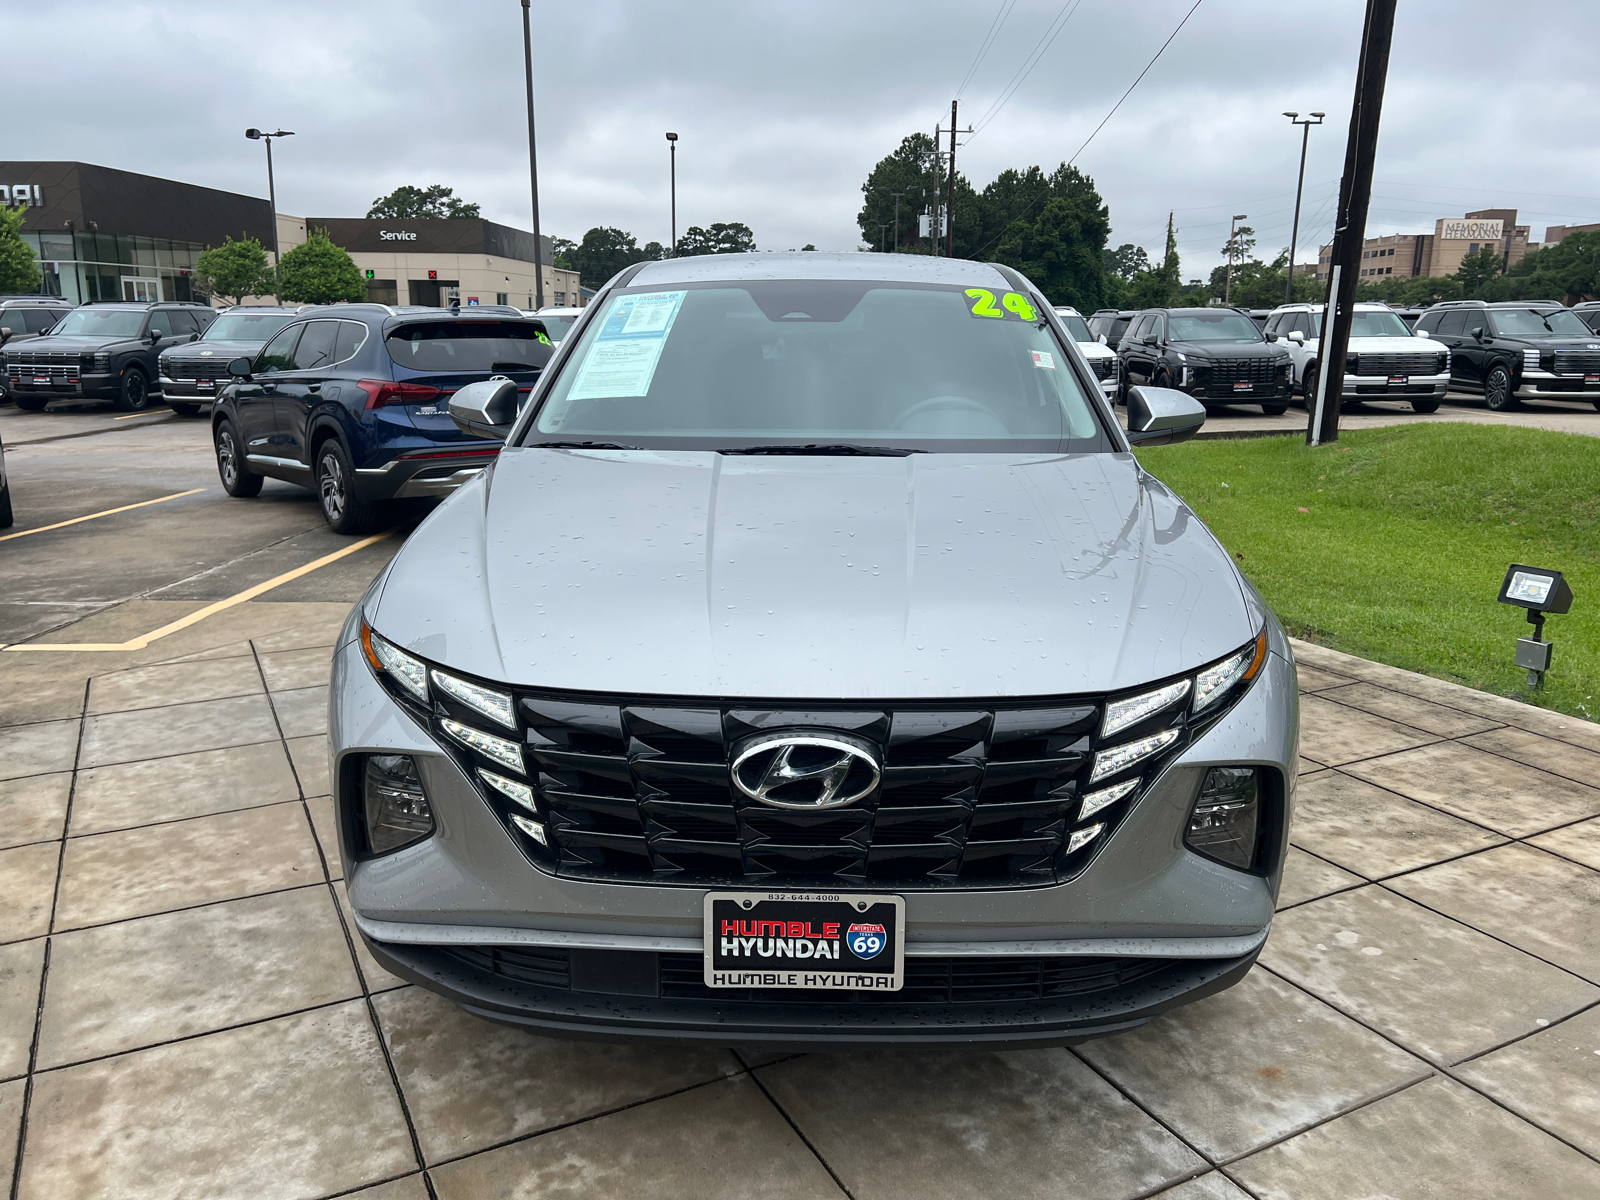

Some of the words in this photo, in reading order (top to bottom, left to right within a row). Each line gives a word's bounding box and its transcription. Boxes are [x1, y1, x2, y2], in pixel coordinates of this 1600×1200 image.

[1445, 230, 1500, 238] HERMANN
[1446, 223, 1499, 231] MEMORIAL
[379, 230, 417, 241] Service
[965, 289, 1038, 321] 24
[534, 330, 552, 347] 22
[768, 893, 840, 902] 832-644-4000
[721, 919, 840, 939] HUMBLE
[720, 937, 840, 960] HYUNDAI
[853, 937, 881, 954] 69
[713, 973, 798, 986] HUMBLE
[804, 974, 895, 989] HYUNDAI
